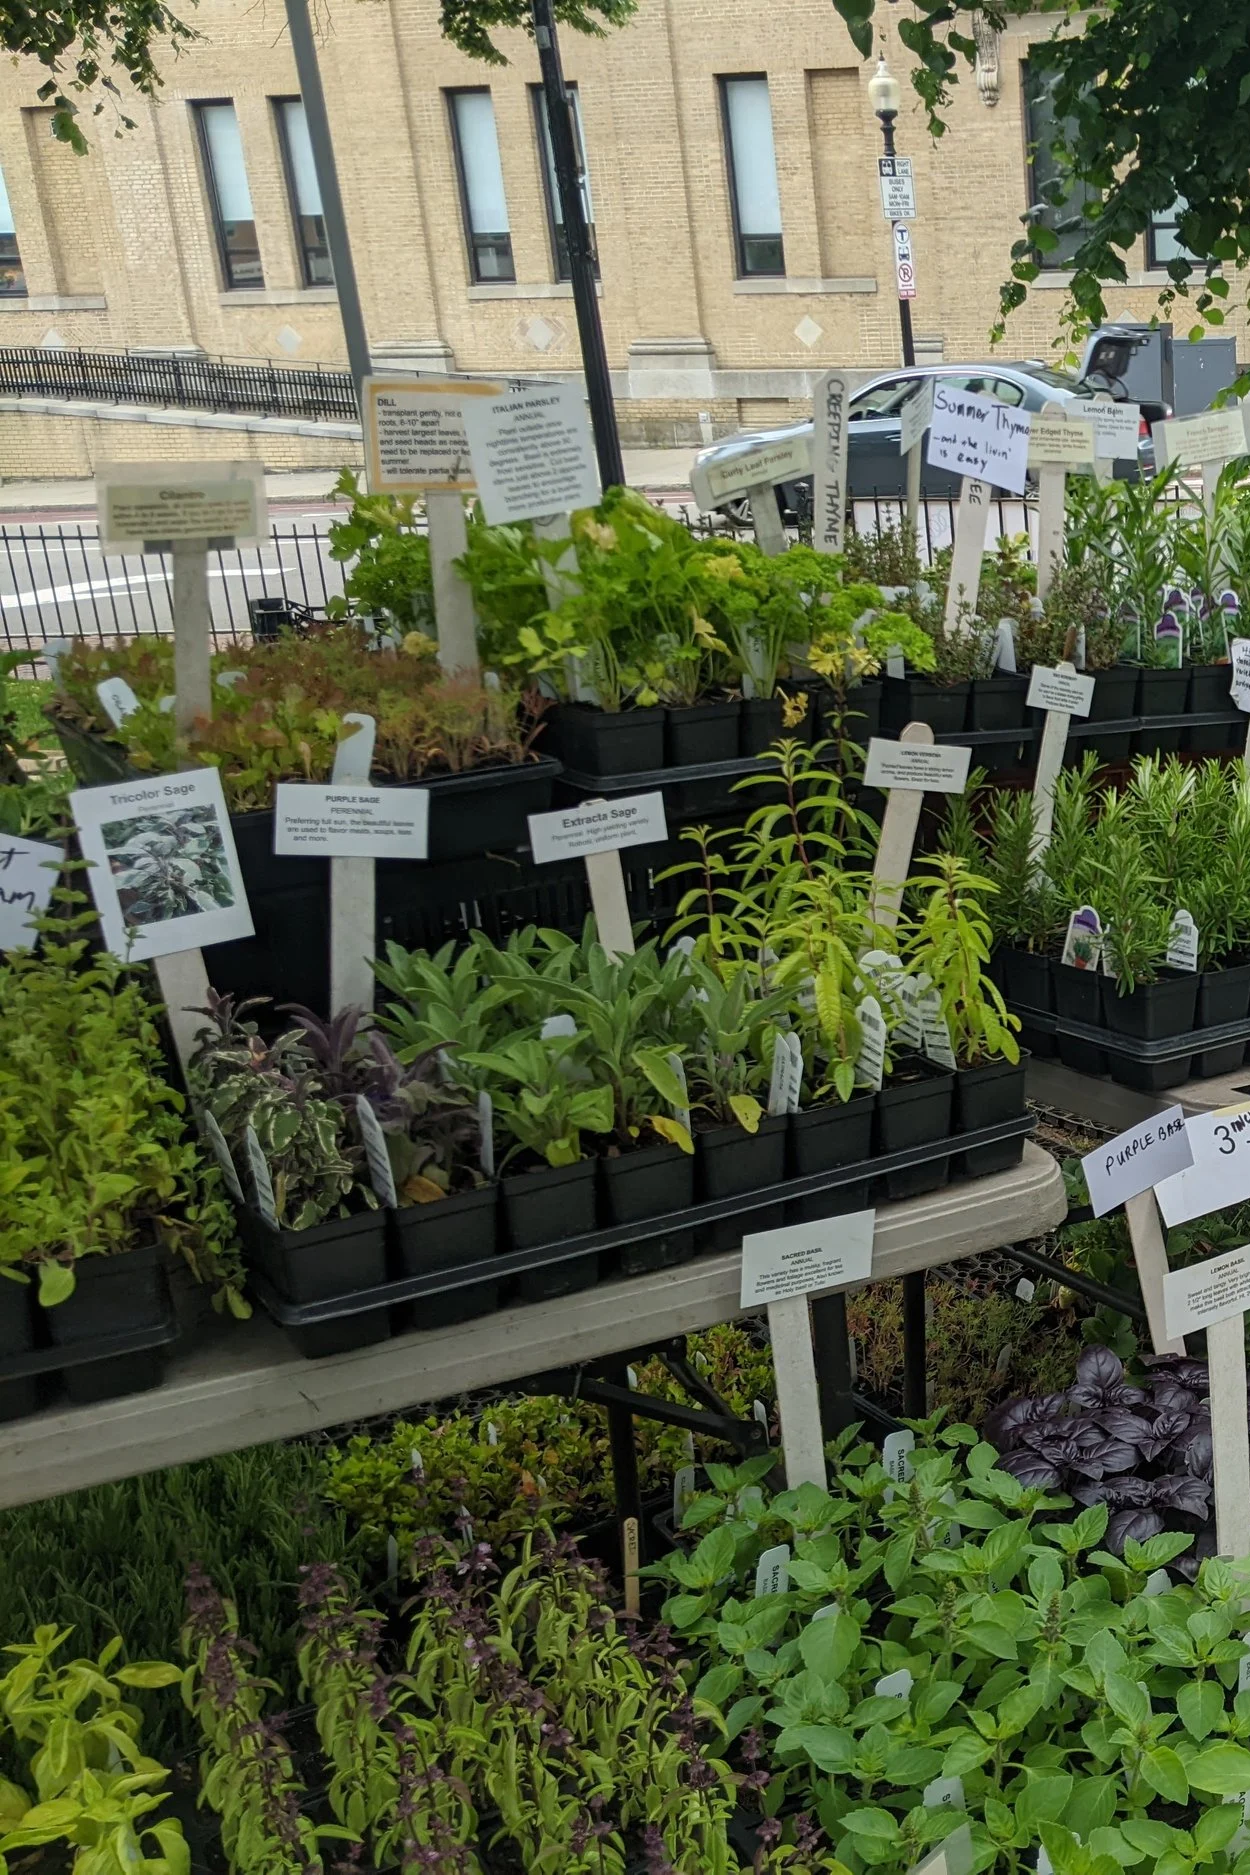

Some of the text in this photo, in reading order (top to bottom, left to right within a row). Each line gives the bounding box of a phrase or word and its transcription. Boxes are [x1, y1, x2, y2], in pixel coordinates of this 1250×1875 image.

[492, 397, 560, 414] ITALIAN PARSLEY
[934, 390, 989, 421] Summer
[1083, 405, 1105, 413] Lemon
[1041, 428, 1083, 437] Edged Thyme
[825, 380, 844, 546] CREEPING THYME
[940, 449, 989, 474] is easy
[110, 783, 196, 806] Tricolor Sage
[326, 795, 358, 803] PURPLE
[285, 817, 320, 825] Preferring
[562, 807, 637, 828] Extracta Sage
[1214, 1125, 1236, 1155] 3
[1106, 1134, 1155, 1176] PURPLE
[781, 1247, 823, 1261] SACRED BASIL
[1210, 1258, 1245, 1275] LEMON BASIL
[1203, 1286, 1213, 1294] and
[897, 1449, 905, 1483] SACRED
